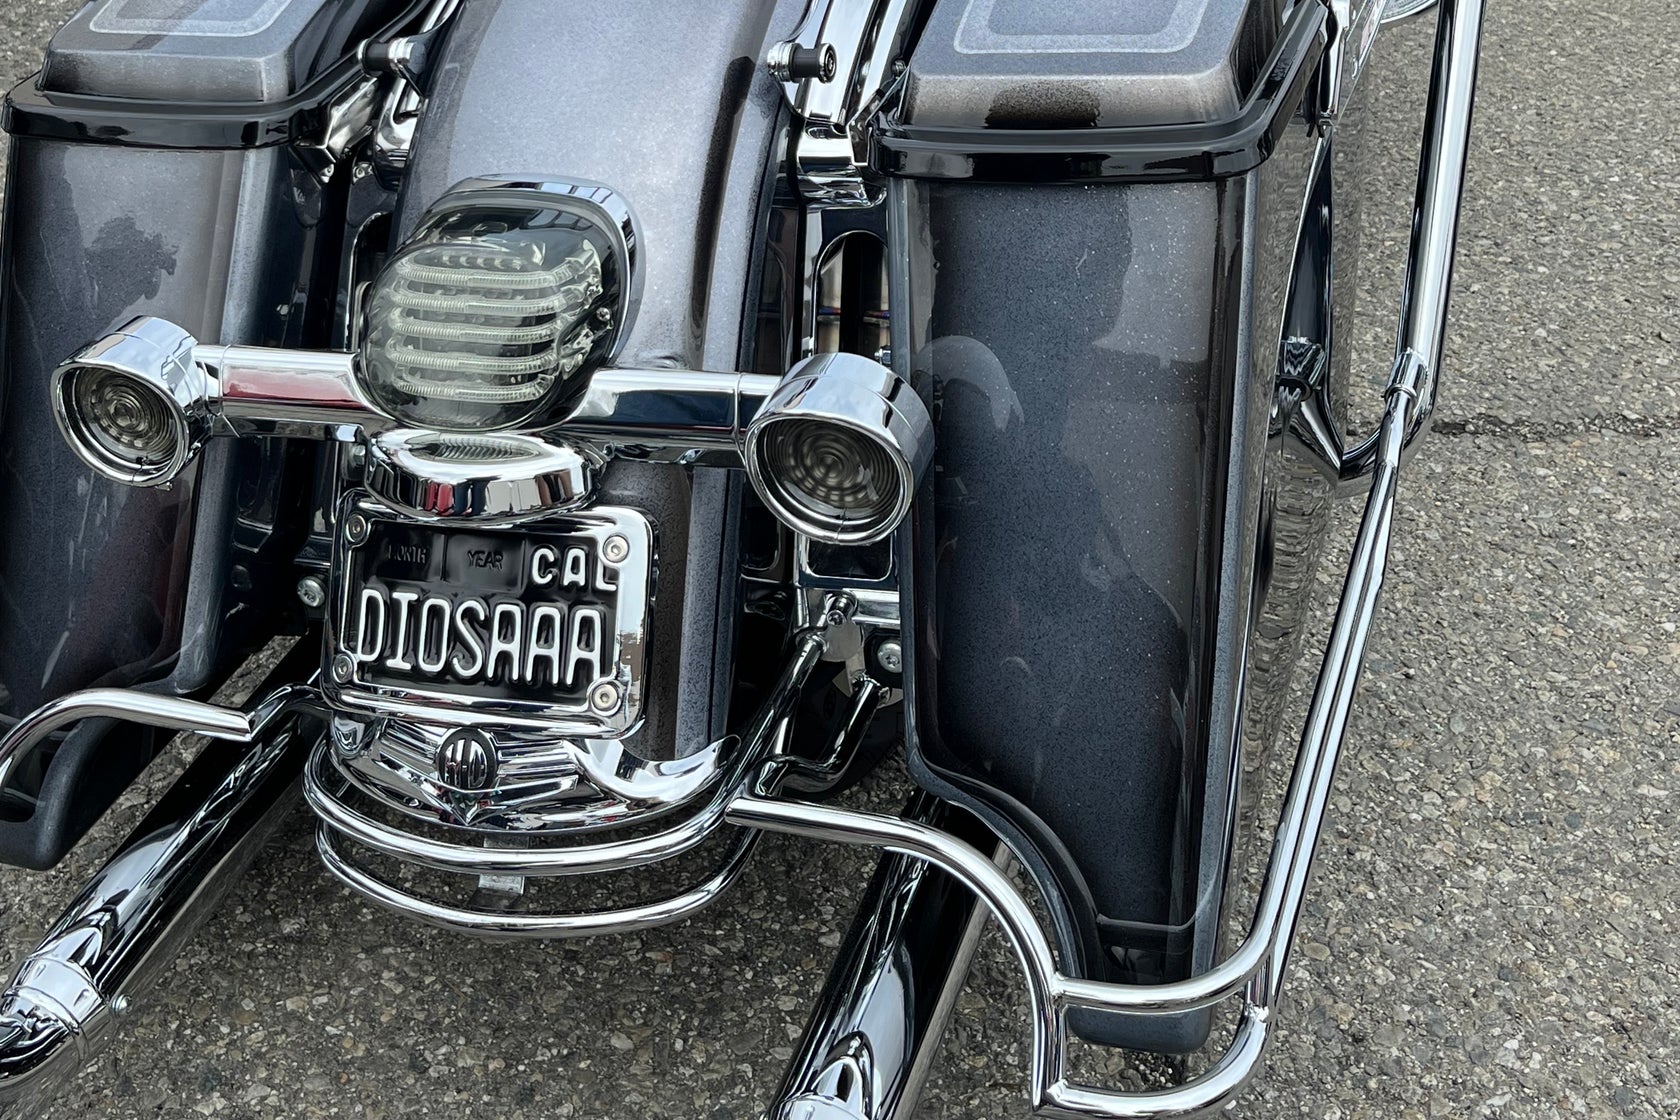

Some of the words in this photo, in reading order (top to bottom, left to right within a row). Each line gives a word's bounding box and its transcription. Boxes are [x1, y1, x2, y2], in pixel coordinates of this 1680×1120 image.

[467, 549, 503, 571] YEAR
[531, 547, 617, 591] CAL
[357, 589, 602, 686] DIOSAAA
